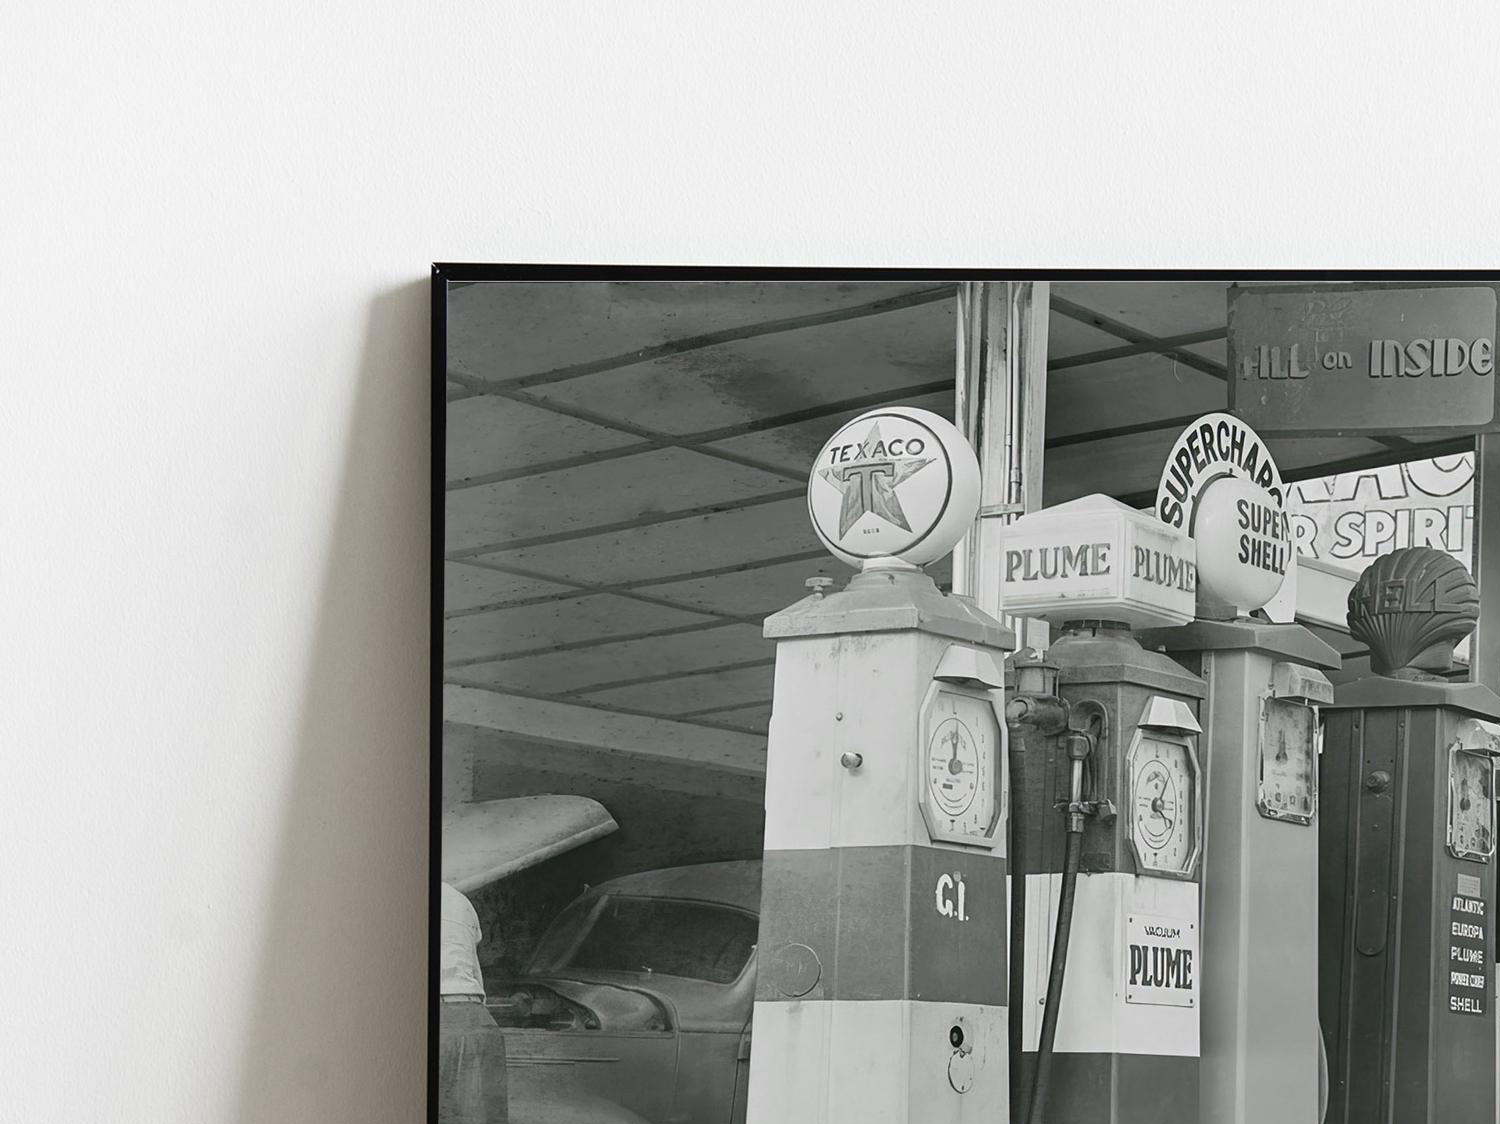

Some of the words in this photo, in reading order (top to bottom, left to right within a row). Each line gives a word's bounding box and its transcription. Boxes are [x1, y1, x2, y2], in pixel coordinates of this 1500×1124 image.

[1322, 351, 1353, 370] on
[829, 438, 926, 465] TEXACO
[1329, 505, 1474, 559] SPIRI
[1004, 542, 1112, 583] PLUME
[1132, 544, 1197, 593] PLUME
[1237, 533, 1286, 577] SHELL
[1451, 921, 1484, 940] EUROPA
[1129, 944, 1193, 990] PLUME
[1450, 946, 1484, 964] PLUME
[1450, 996, 1483, 1013] SHELL
